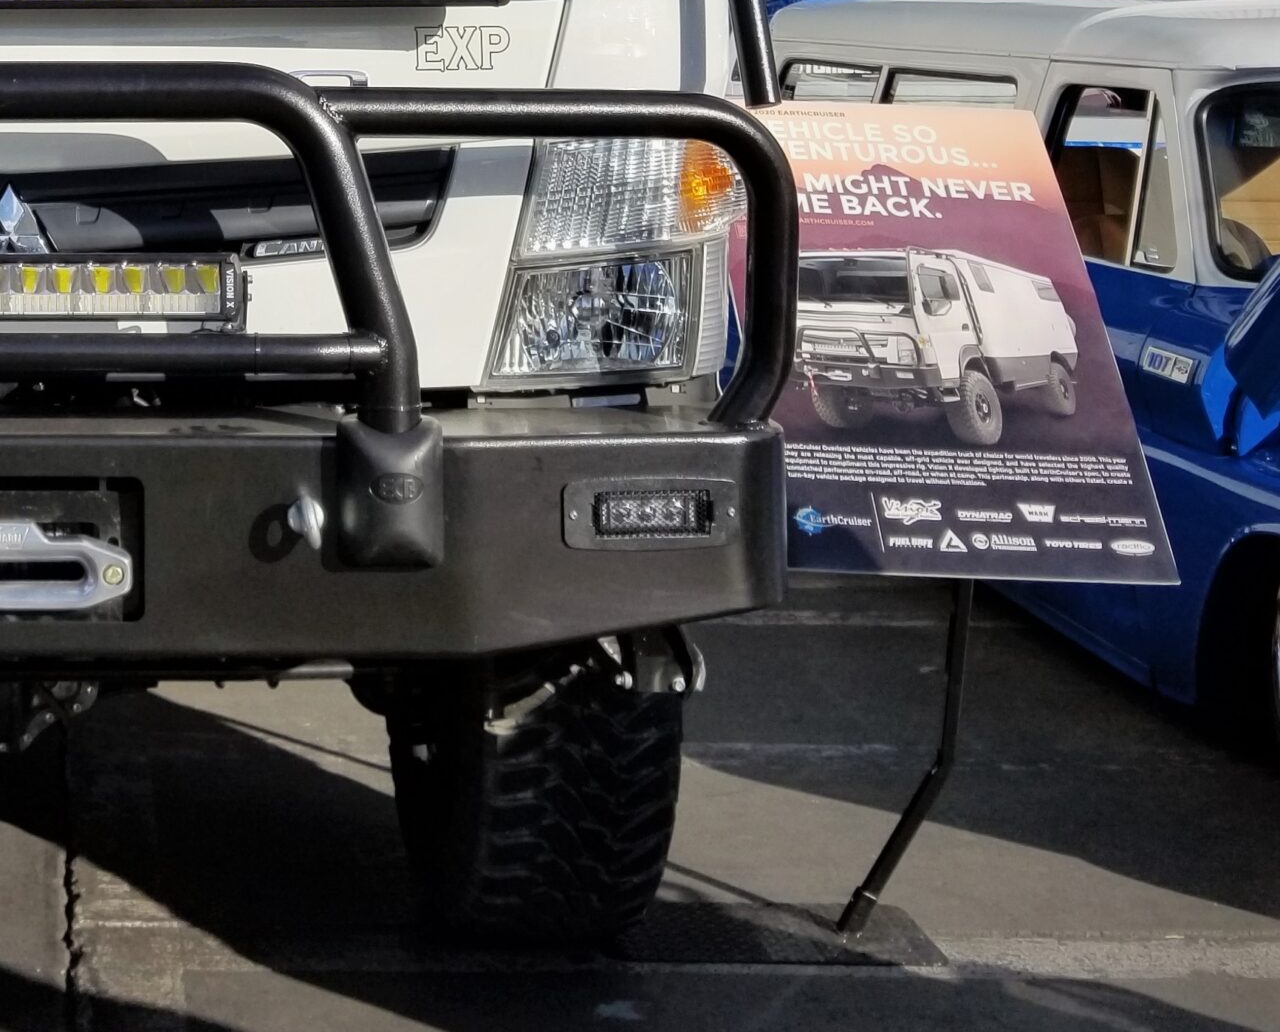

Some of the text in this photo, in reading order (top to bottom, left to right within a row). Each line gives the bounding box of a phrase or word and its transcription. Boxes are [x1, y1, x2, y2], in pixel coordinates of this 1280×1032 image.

[414, 24, 510, 72] EXP
[778, 110, 846, 118] EARTHCRUISER
[764, 118, 937, 145] EHICLE SO
[779, 139, 998, 169] ENTUROUS...
[803, 172, 1036, 202] MIGHT NEVER
[840, 194, 943, 219] BACK.
[799, 216, 875, 227] ARTHCRUISER.COM
[225, 268, 235, 309] VISION X
[809, 514, 873, 528] EarthCruiser
[957, 510, 1013, 520] DYNATRAC
[990, 533, 1036, 546] Allison
